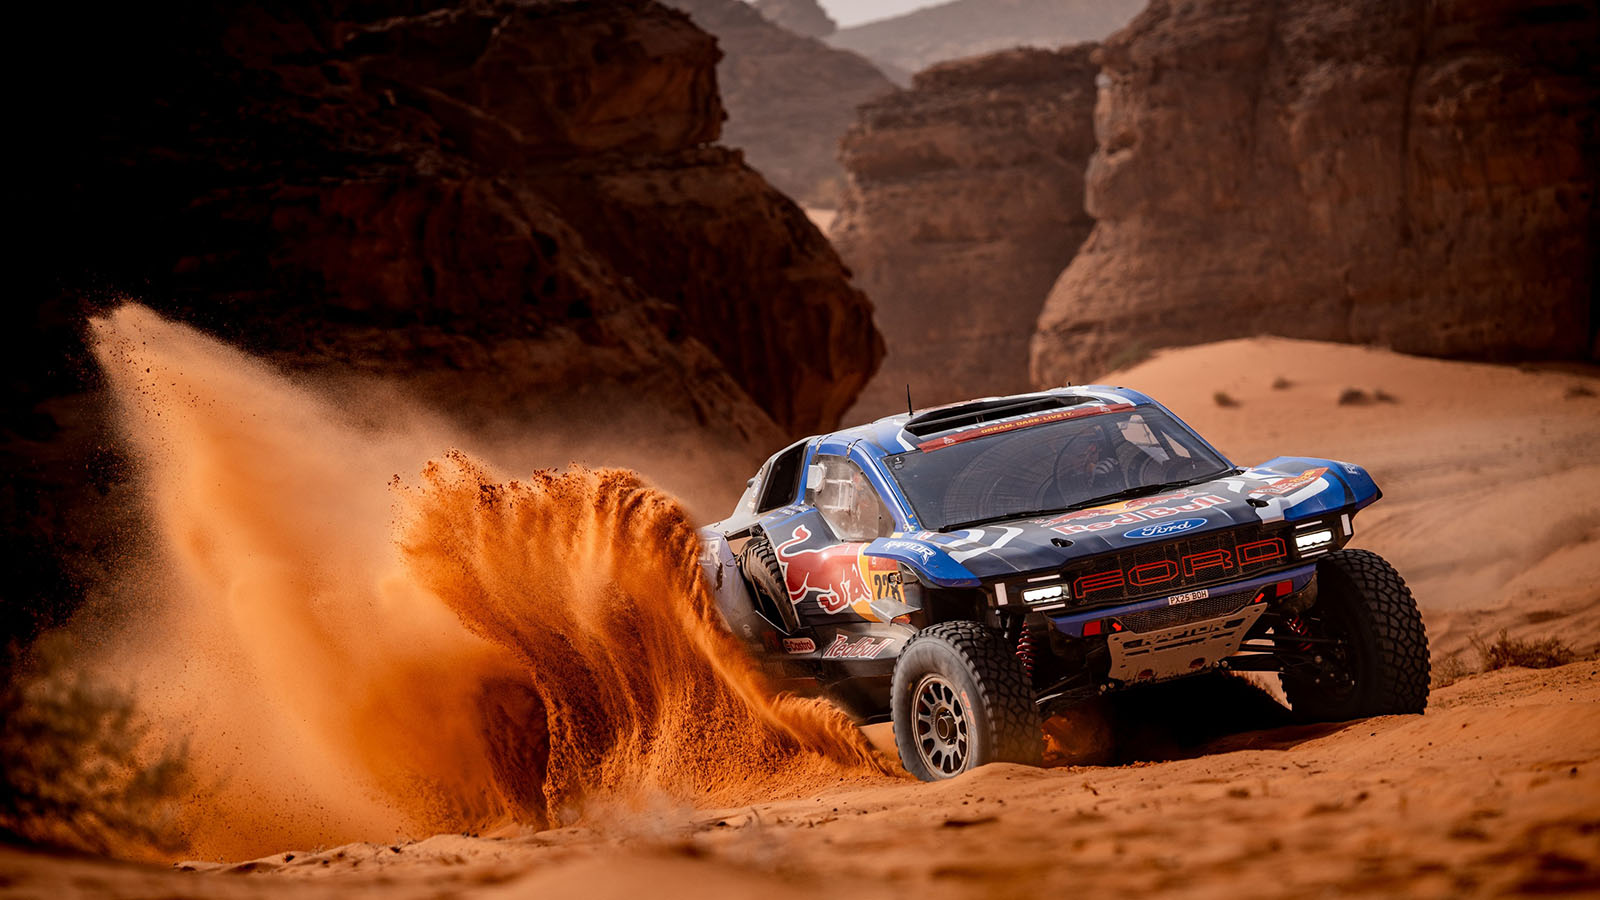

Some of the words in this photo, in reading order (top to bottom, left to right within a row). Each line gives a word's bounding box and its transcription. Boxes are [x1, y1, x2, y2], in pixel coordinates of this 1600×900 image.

[980, 423, 1015, 434] DREAM.
[1016, 417, 1042, 428] DARE.
[1043, 413, 1063, 422] LIVE
[1050, 512, 1148, 535] Red
[1138, 494, 1231, 519] Bull
[1141, 520, 1192, 536] Ford
[1073, 537, 1288, 599] FORD
